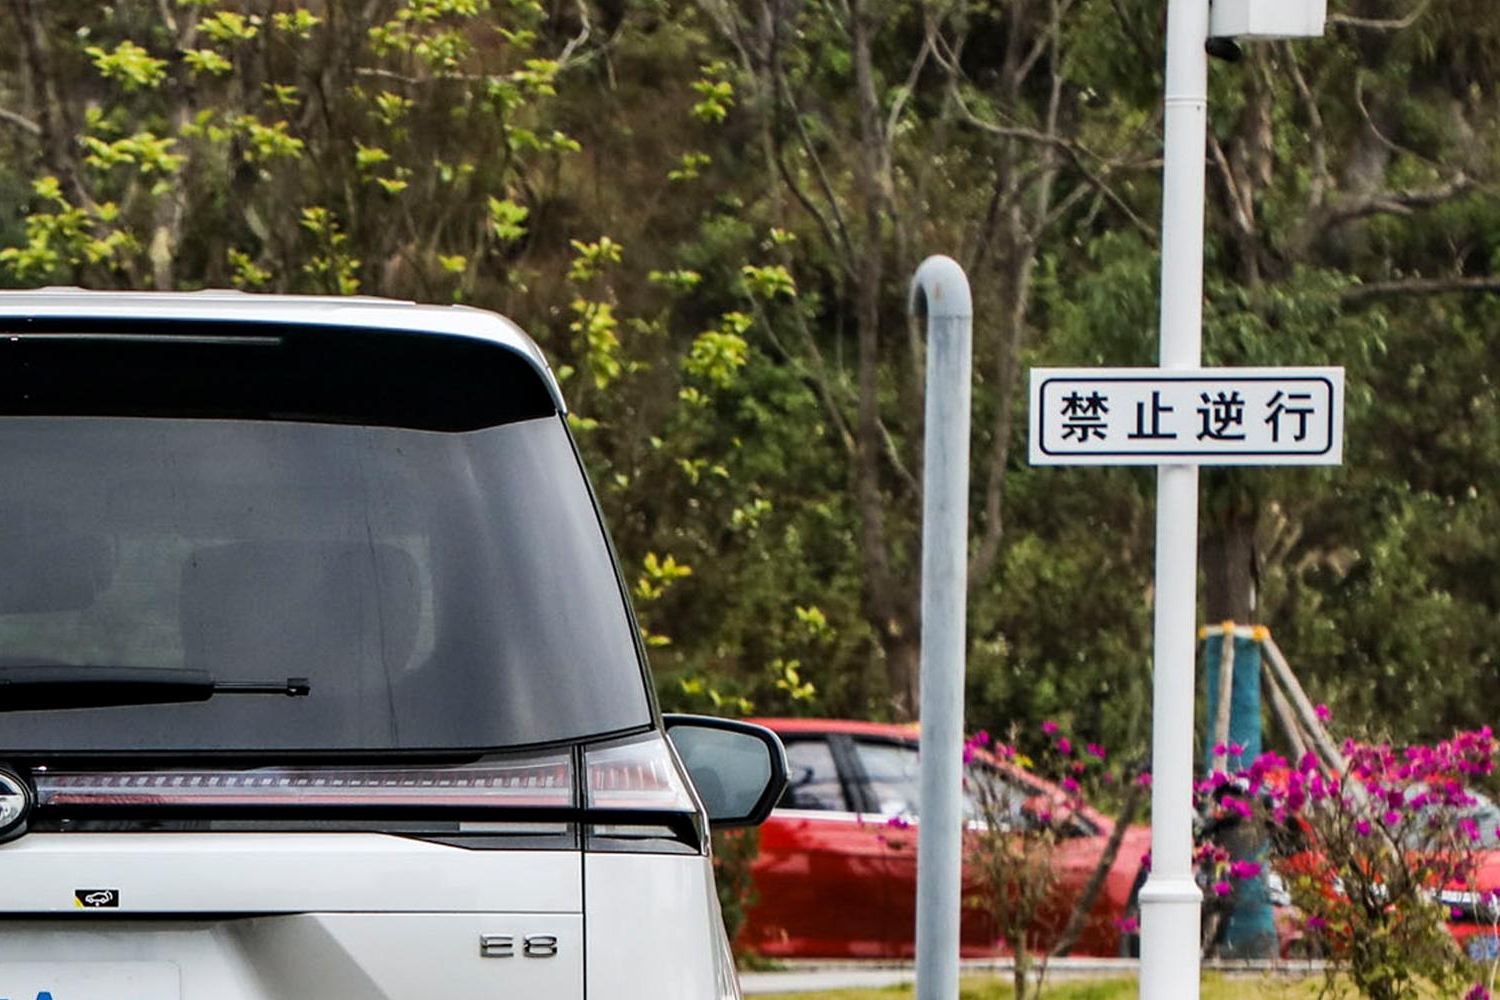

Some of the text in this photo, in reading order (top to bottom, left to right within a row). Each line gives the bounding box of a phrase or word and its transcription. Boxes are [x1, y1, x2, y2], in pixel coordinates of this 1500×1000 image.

[1060, 390, 1315, 443] 禁止逆行
[480, 933, 558, 958] E8
